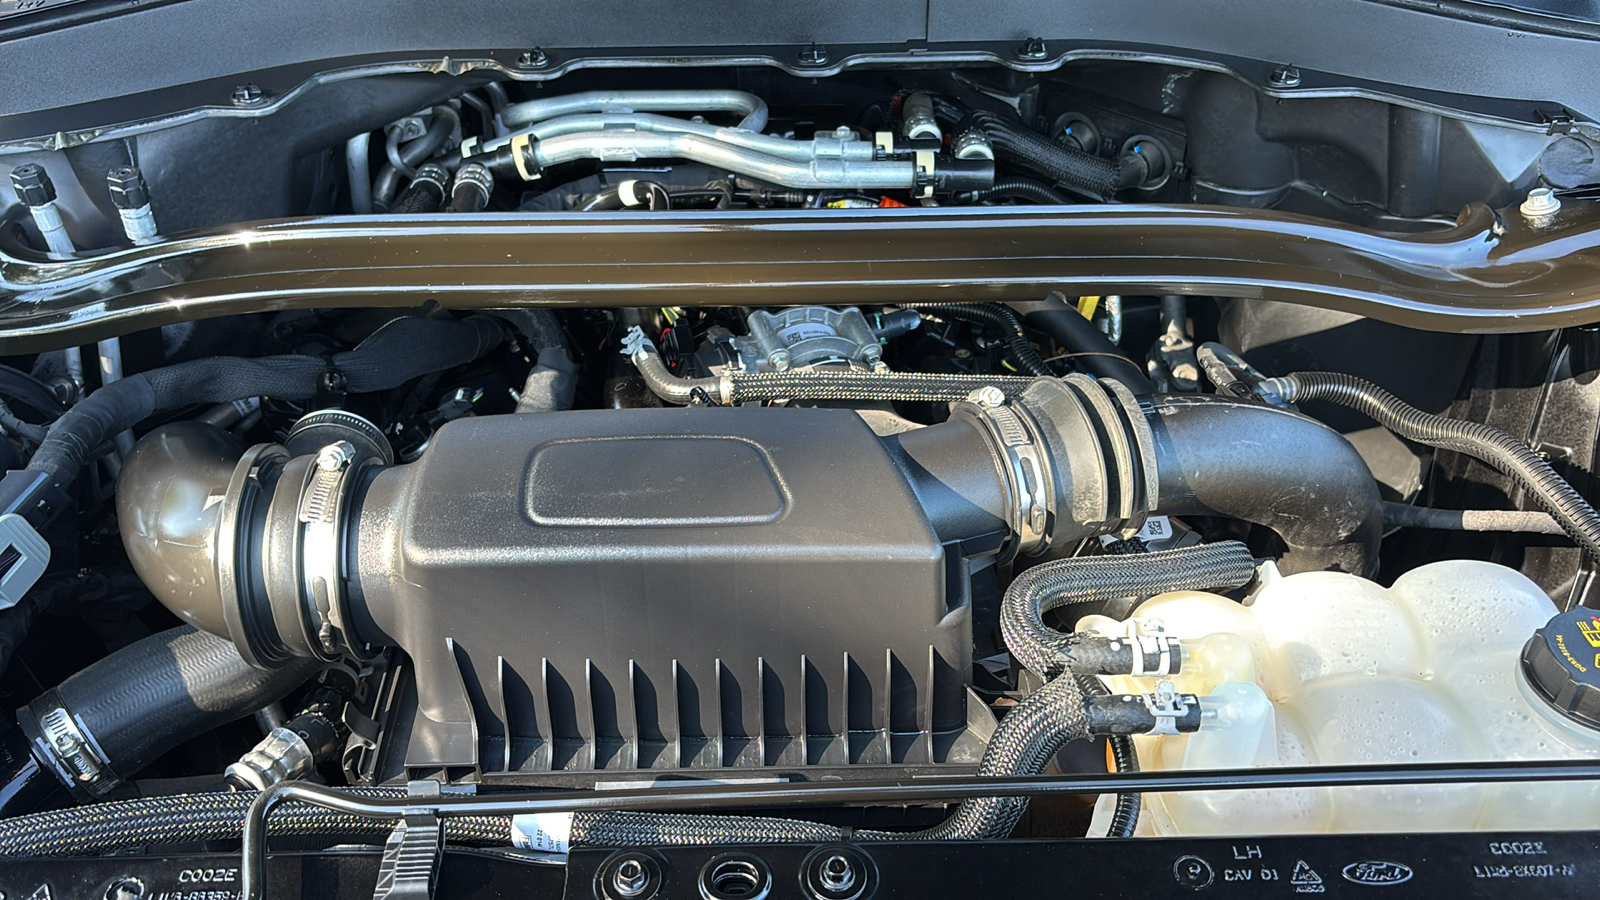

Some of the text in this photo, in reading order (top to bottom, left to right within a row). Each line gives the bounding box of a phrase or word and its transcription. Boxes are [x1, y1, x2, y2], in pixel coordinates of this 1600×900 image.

[1232, 845, 1262, 859] LH
[1224, 869, 1252, 881] CAV
[1352, 862, 1404, 883] Ford
